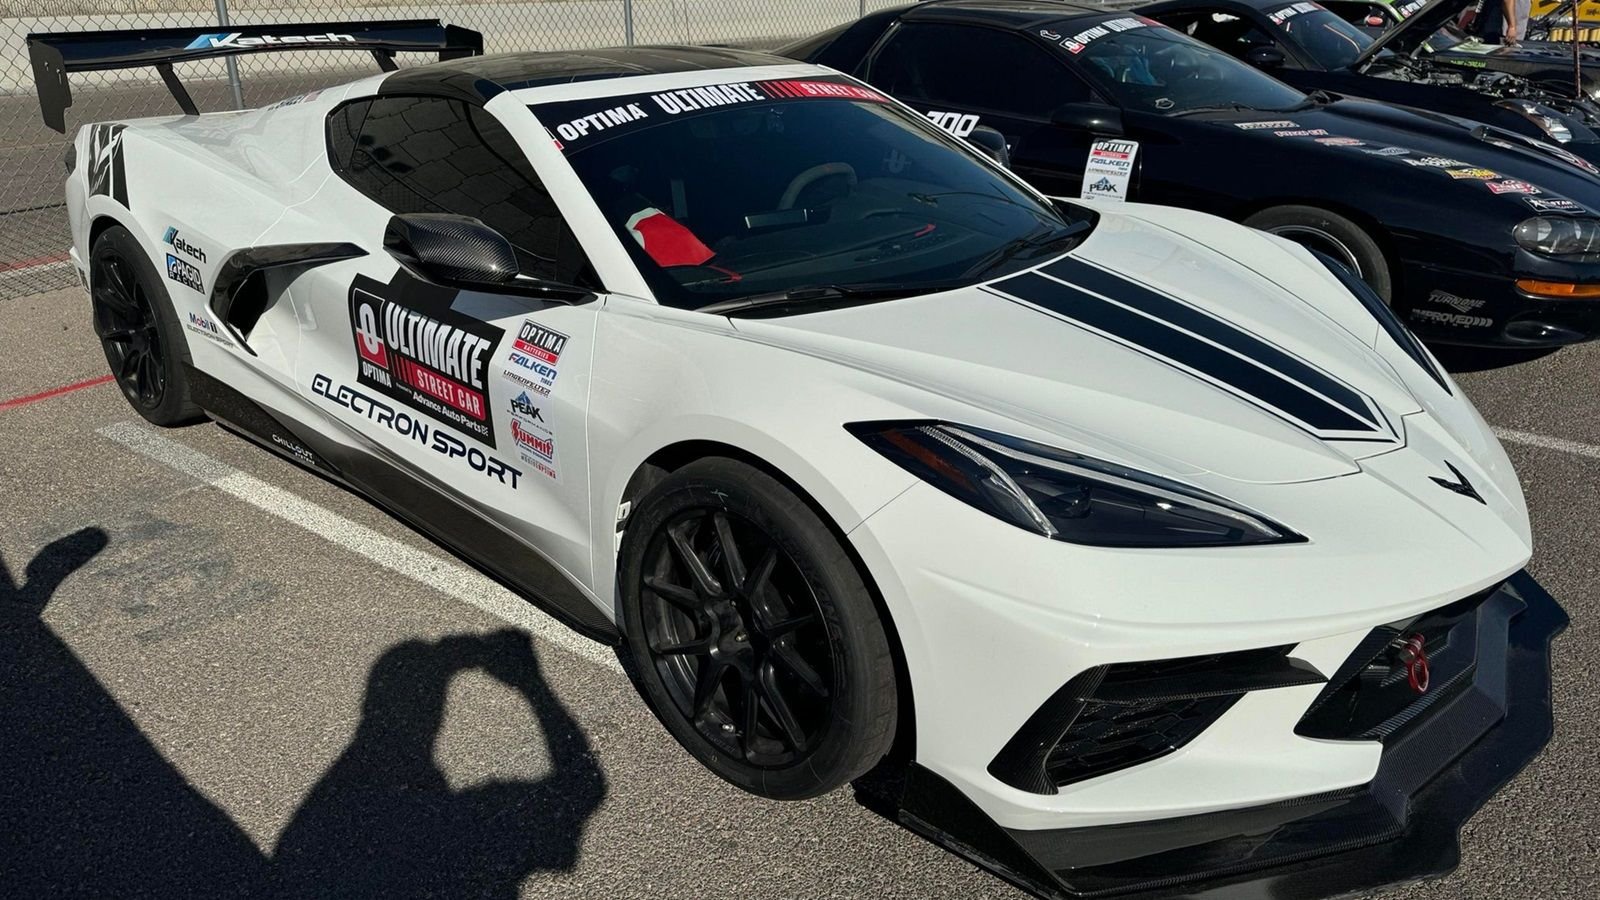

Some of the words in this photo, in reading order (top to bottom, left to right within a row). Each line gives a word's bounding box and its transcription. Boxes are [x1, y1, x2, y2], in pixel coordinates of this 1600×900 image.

[208, 33, 356, 48] Katech
[557, 103, 649, 141] OPTIMA
[651, 82, 765, 114] ULTIMATE
[800, 83, 855, 97] STREET
[1096, 141, 1133, 153] OPTIMA
[1090, 157, 1130, 167] FALKEN
[1089, 183, 1118, 193] PEAK
[168, 229, 207, 264] Katech
[188, 312, 211, 331] Mobil
[385, 301, 491, 390] ULTIMATE
[520, 324, 564, 353] OPTIMA
[362, 361, 393, 388] OPTIMA
[508, 352, 558, 380] FALKEN
[416, 369, 455, 403] STREET
[457, 388, 481, 416] CAR
[412, 391, 442, 413] Advance
[441, 405, 461, 422] Auto
[460, 415, 481, 433] Parts
[510, 399, 545, 423] PEAK
[311, 373, 429, 445] ELECTRON
[431, 429, 523, 489] SPORT
